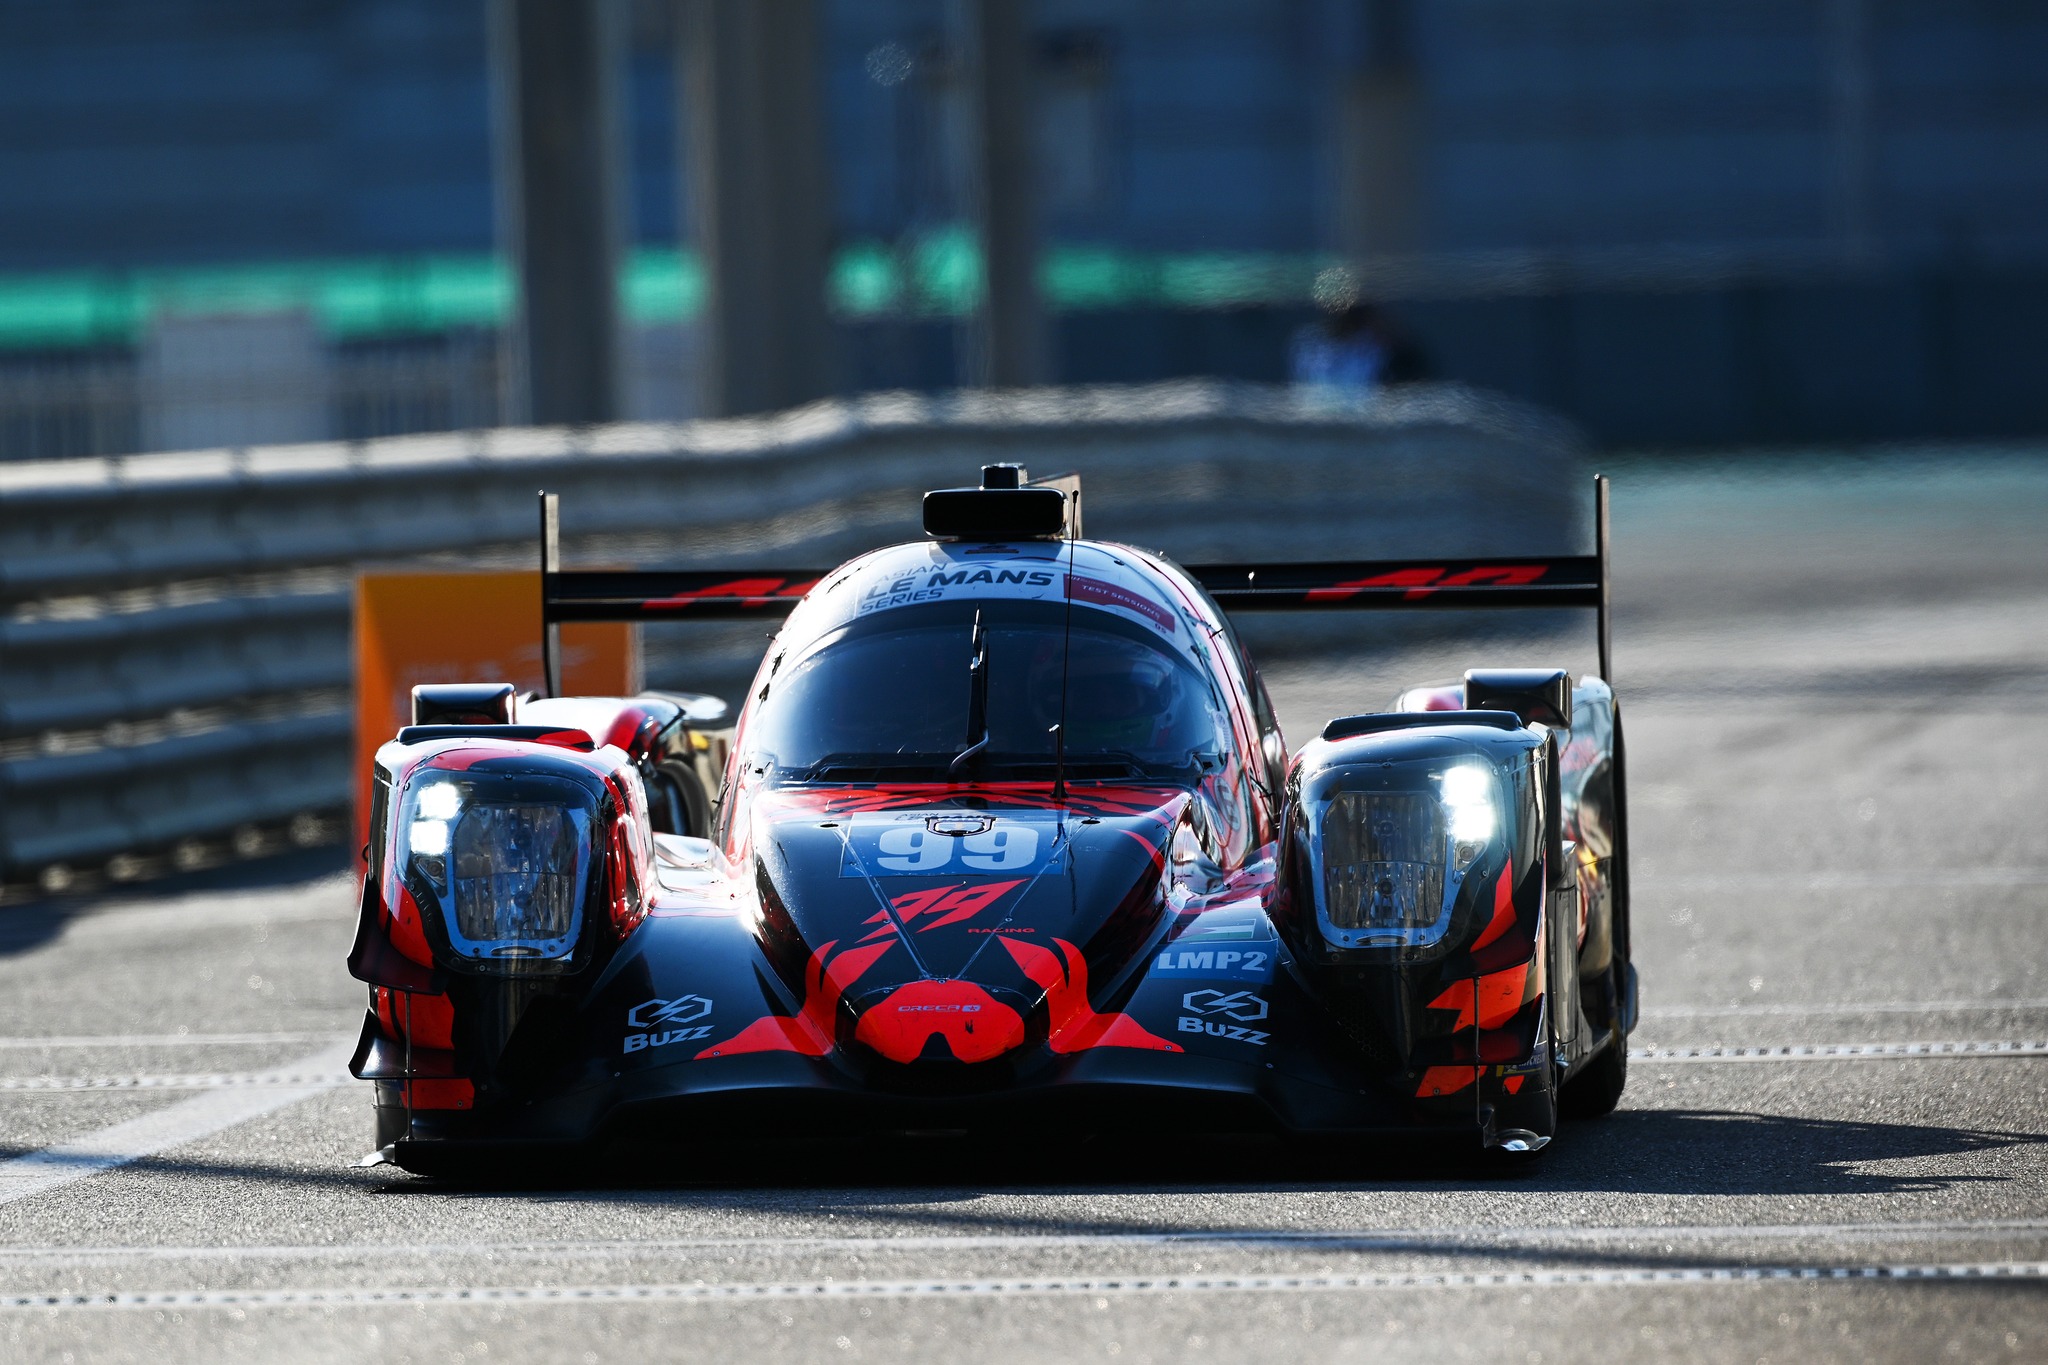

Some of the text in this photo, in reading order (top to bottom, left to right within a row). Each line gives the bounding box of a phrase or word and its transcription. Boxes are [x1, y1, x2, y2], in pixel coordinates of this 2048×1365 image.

[866, 576, 917, 600] LE
[927, 569, 1055, 588] MANS
[861, 587, 945, 613] SERIES
[1082, 584, 1160, 620] TEST SESSIONS
[877, 827, 1039, 871] 99
[1157, 951, 1268, 972] LMP2
[623, 1025, 715, 1054] BUZZ
[1177, 1016, 1271, 1046] BUZZ
